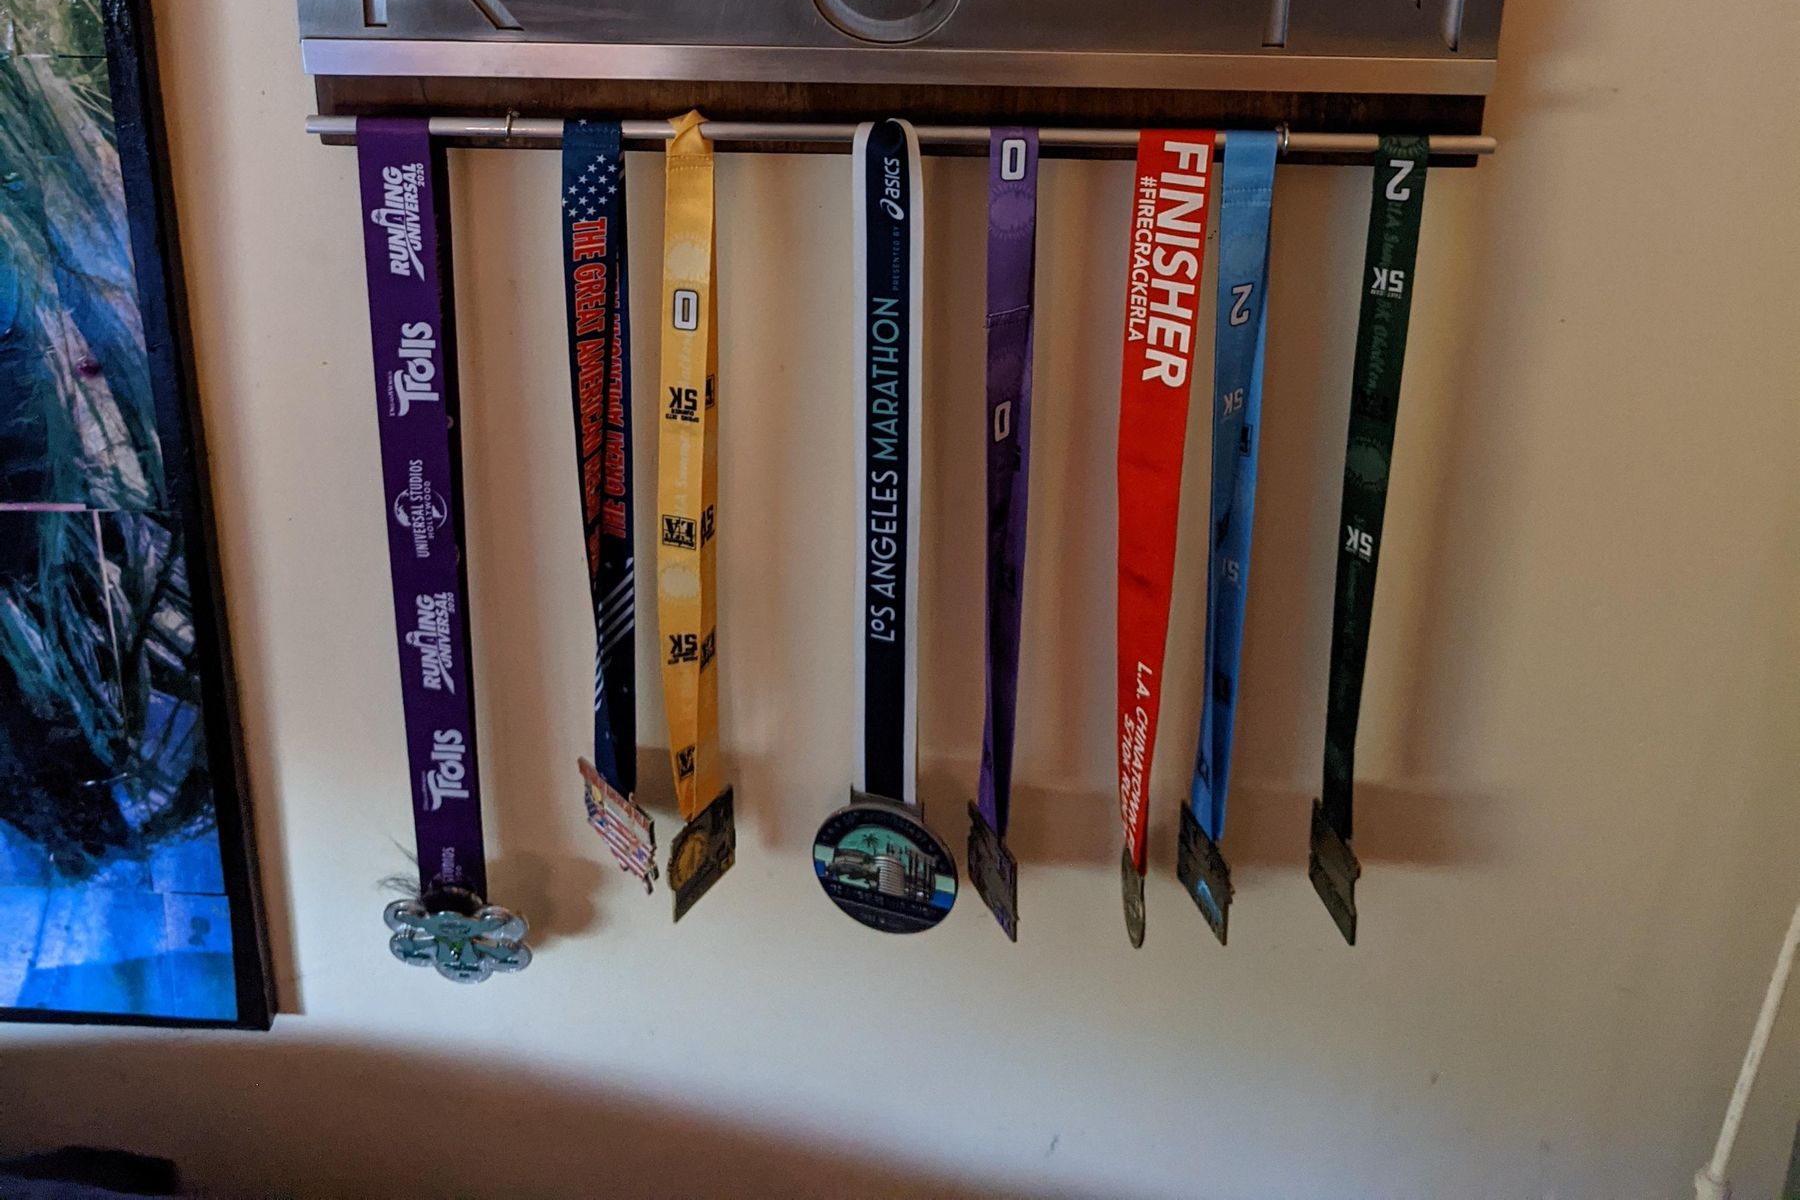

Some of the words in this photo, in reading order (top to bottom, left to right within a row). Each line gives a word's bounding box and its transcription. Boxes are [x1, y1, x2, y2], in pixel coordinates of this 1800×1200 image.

[402, 163, 423, 251] UNIVERSAL
[416, 163, 425, 187] 2020
[1385, 159, 1415, 201] 2
[372, 166, 411, 277] RUNNING
[572, 216, 608, 262] THE
[1128, 176, 1157, 342] #FIRECRACKERLA
[573, 262, 608, 337] GREAT
[1142, 140, 1209, 388] FINISHER
[1230, 283, 1253, 326] 2
[872, 297, 900, 462] MARATHON
[409, 459, 424, 503] STUDIOS
[423, 481, 435, 539] HOLLYWOOD
[410, 505, 430, 559] UNIVERSAL
[871, 469, 899, 599] ANGELES
[406, 593, 442, 691] RUNNING
[434, 591, 454, 668] UNIVERSAL
